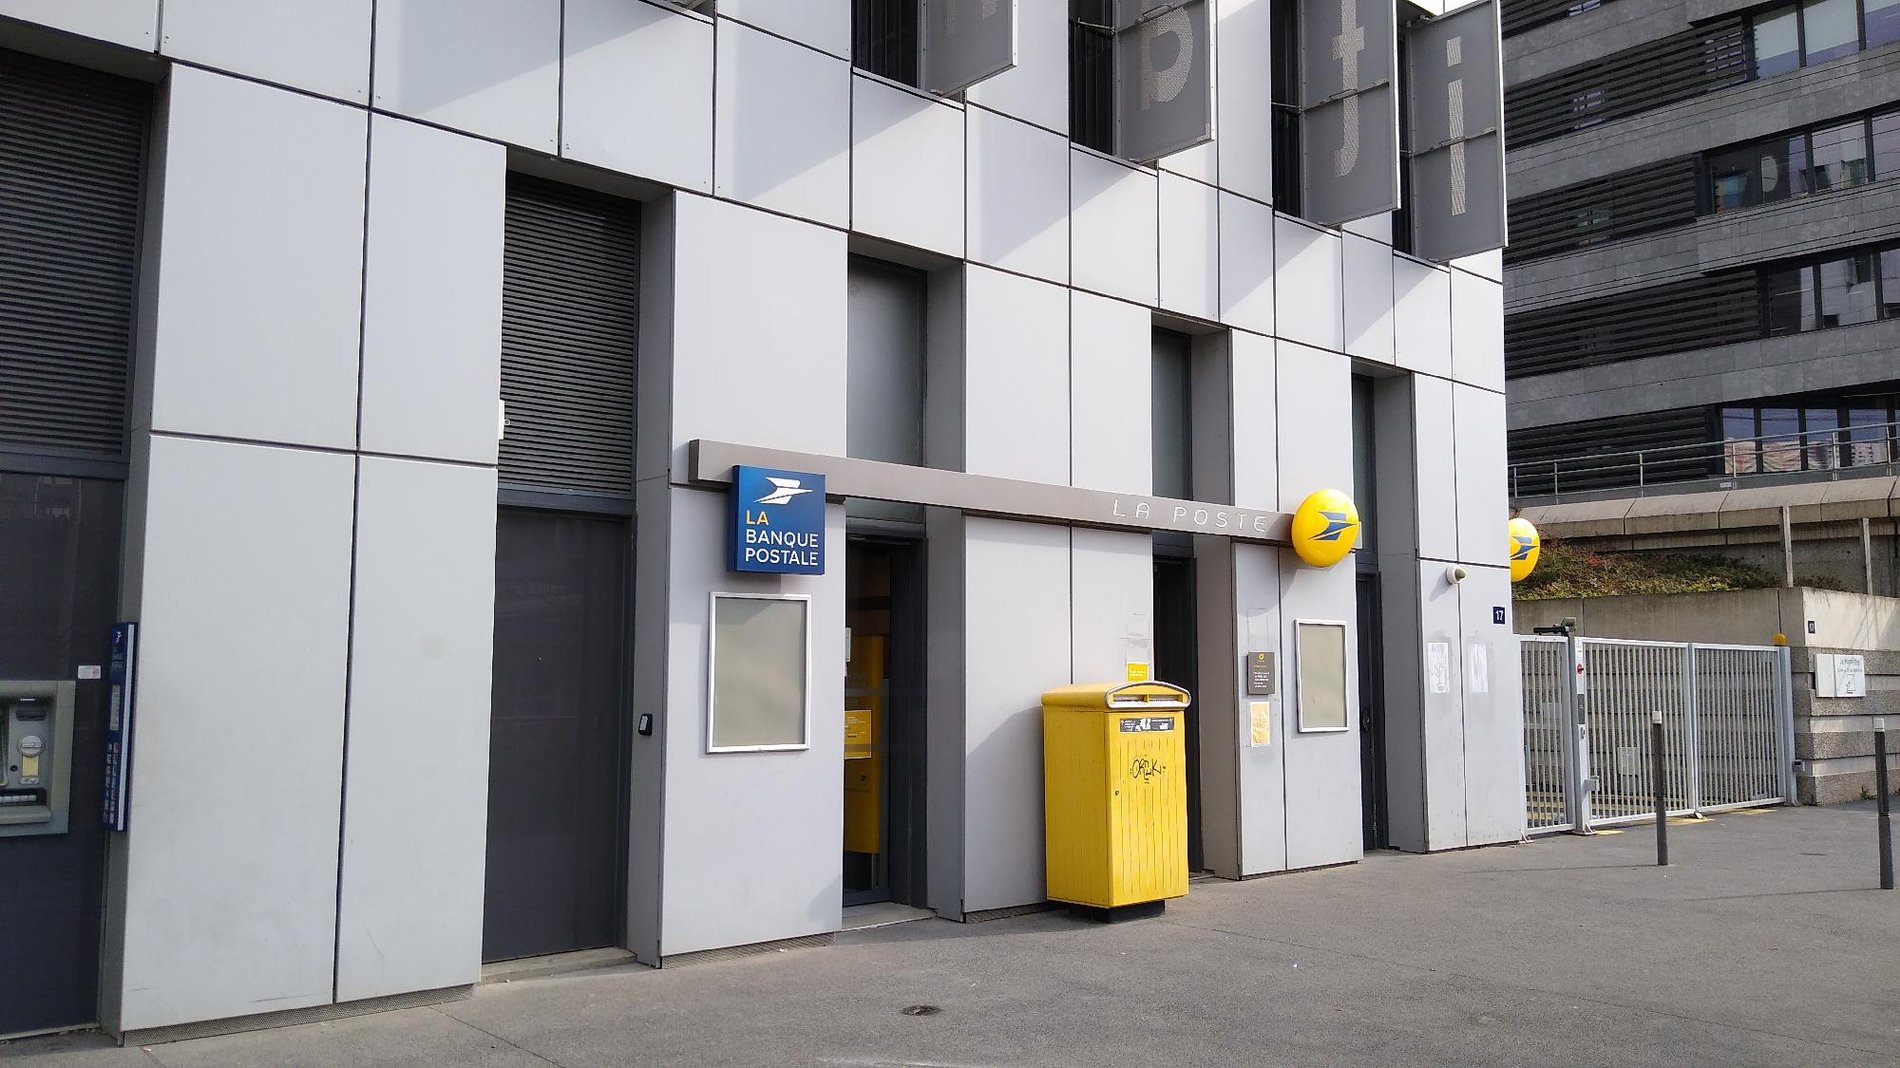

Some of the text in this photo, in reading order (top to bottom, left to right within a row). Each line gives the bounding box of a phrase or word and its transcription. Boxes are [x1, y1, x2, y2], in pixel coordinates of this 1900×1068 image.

[746, 510, 769, 526] LA
[1112, 499, 1267, 532] LA POSTE
[746, 529, 818, 548] BANQUE
[745, 548, 818, 566] POSTALE
[1495, 609, 1504, 622] 17
